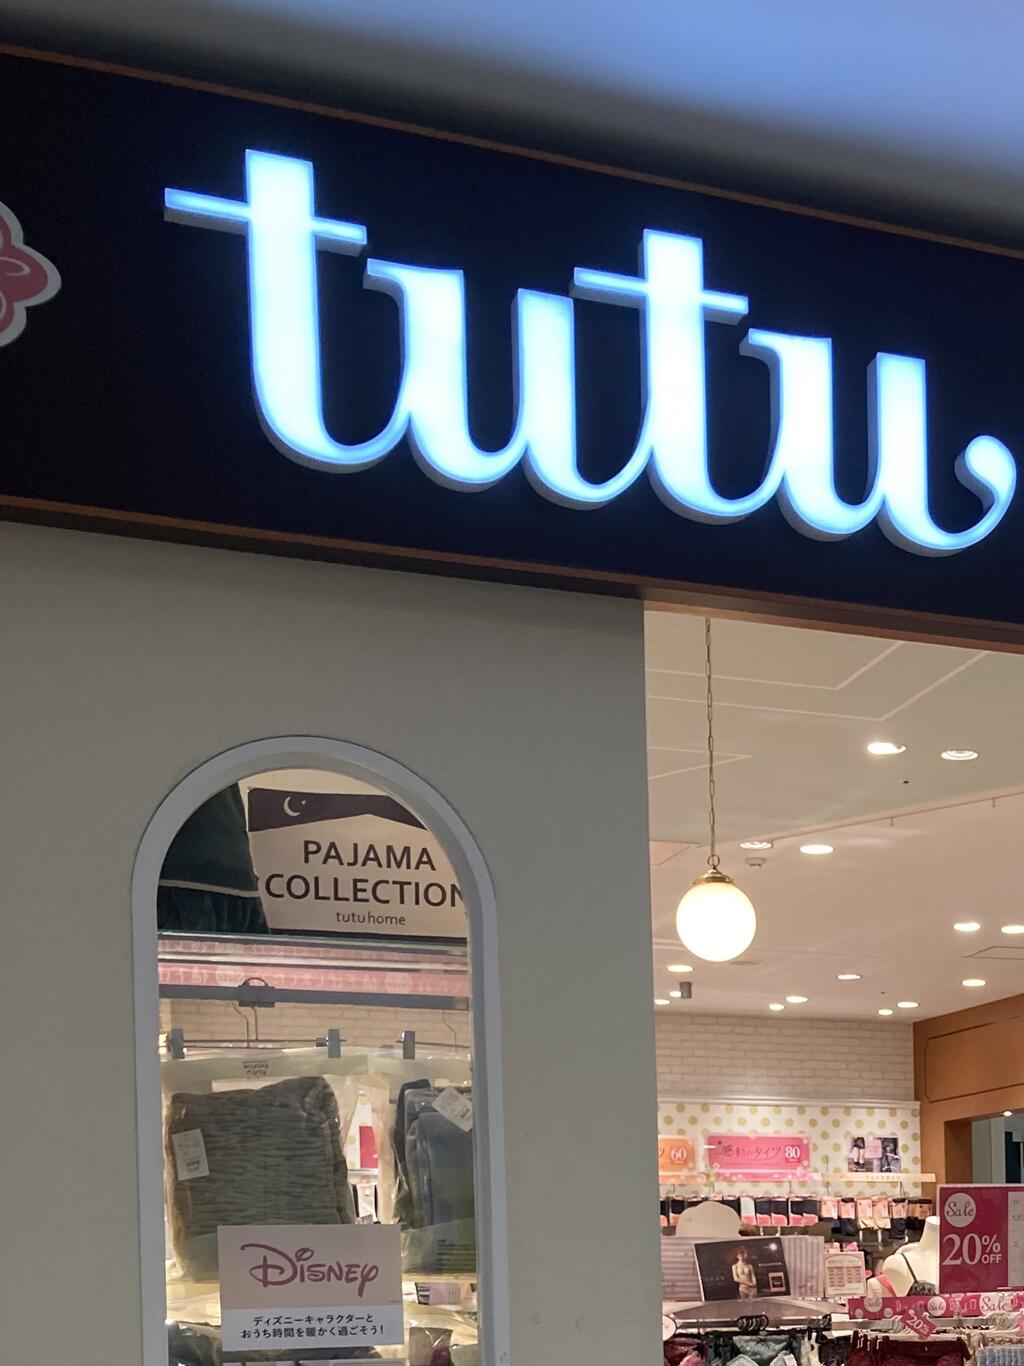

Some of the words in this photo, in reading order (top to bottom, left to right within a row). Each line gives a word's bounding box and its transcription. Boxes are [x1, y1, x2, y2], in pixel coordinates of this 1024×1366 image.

[163, 148, 1018, 557] tutu
[302, 839, 437, 871] PAJAMA
[264, 873, 466, 908] COLLECTION
[946, 1200, 975, 1218] Sale
[942, 1232, 1001, 1266] 20%
[981, 1253, 1002, 1264] OFF
[240, 1324, 385, 1339] おうち時間を暖かく過ごそう!
[253, 1313, 374, 1326] ディズニーキャラクターと
